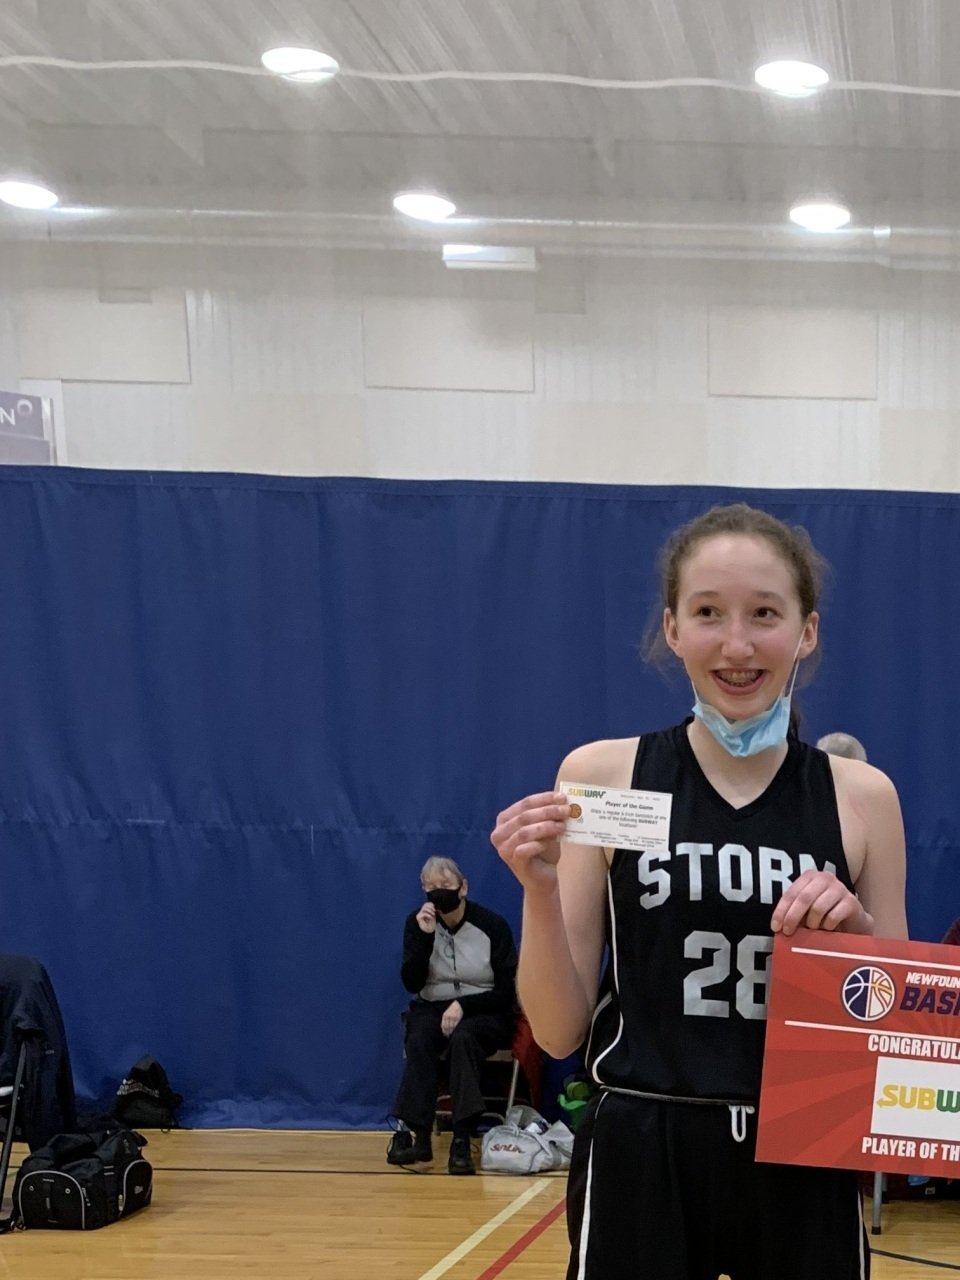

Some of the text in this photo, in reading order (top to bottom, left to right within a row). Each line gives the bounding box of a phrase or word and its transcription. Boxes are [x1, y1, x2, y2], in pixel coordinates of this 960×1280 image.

[567, 788, 606, 799] SUBWAY
[638, 842, 837, 911] STOR
[684, 931, 775, 1020] 28
[861, 1137, 916, 1159] PLAYER
[919, 1142, 938, 1160] OF
